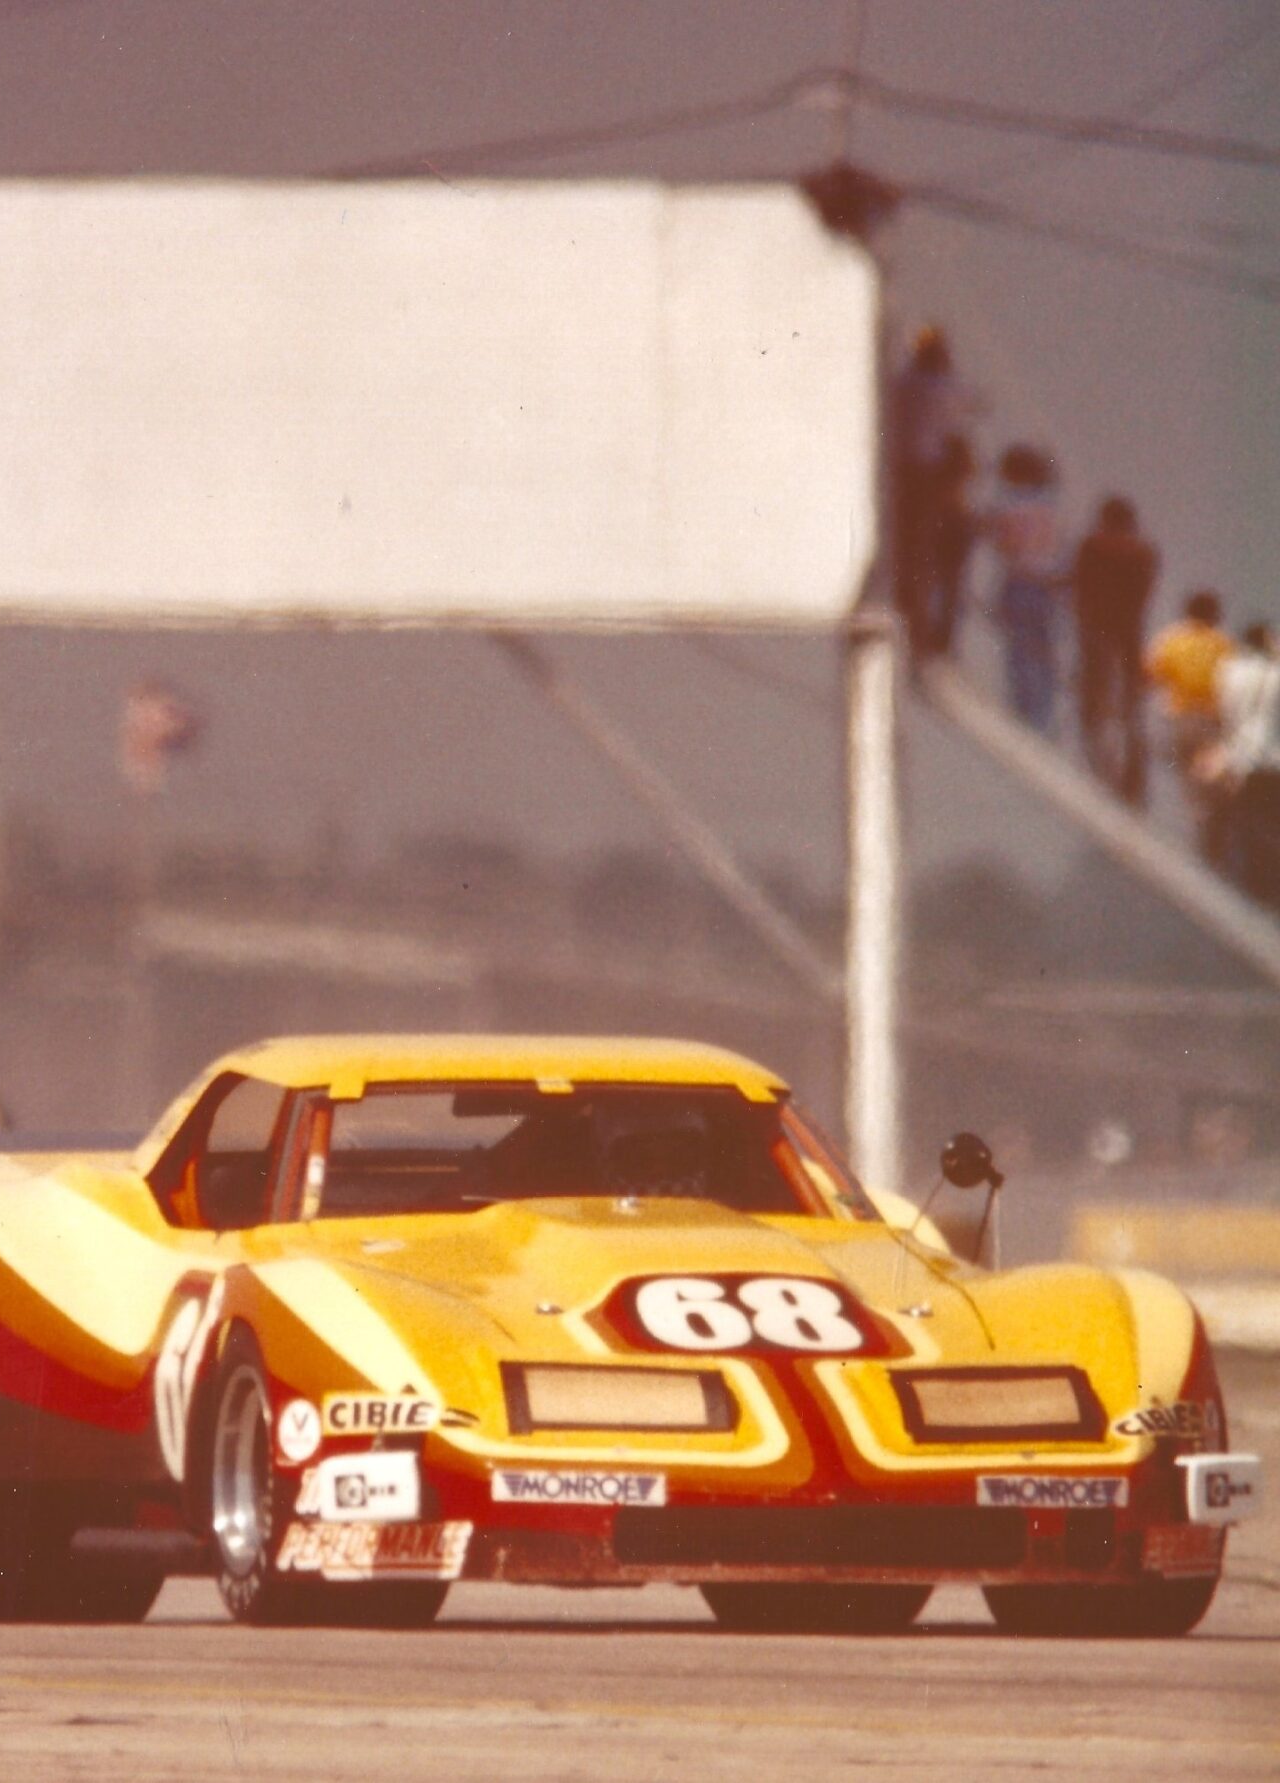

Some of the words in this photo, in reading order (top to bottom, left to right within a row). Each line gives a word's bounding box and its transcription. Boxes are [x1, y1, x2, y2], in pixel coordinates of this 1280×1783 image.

[636, 1278, 863, 1351] 68
[521, 1475, 639, 1500] MONROE
[1002, 1477, 1108, 1504] MONROE
